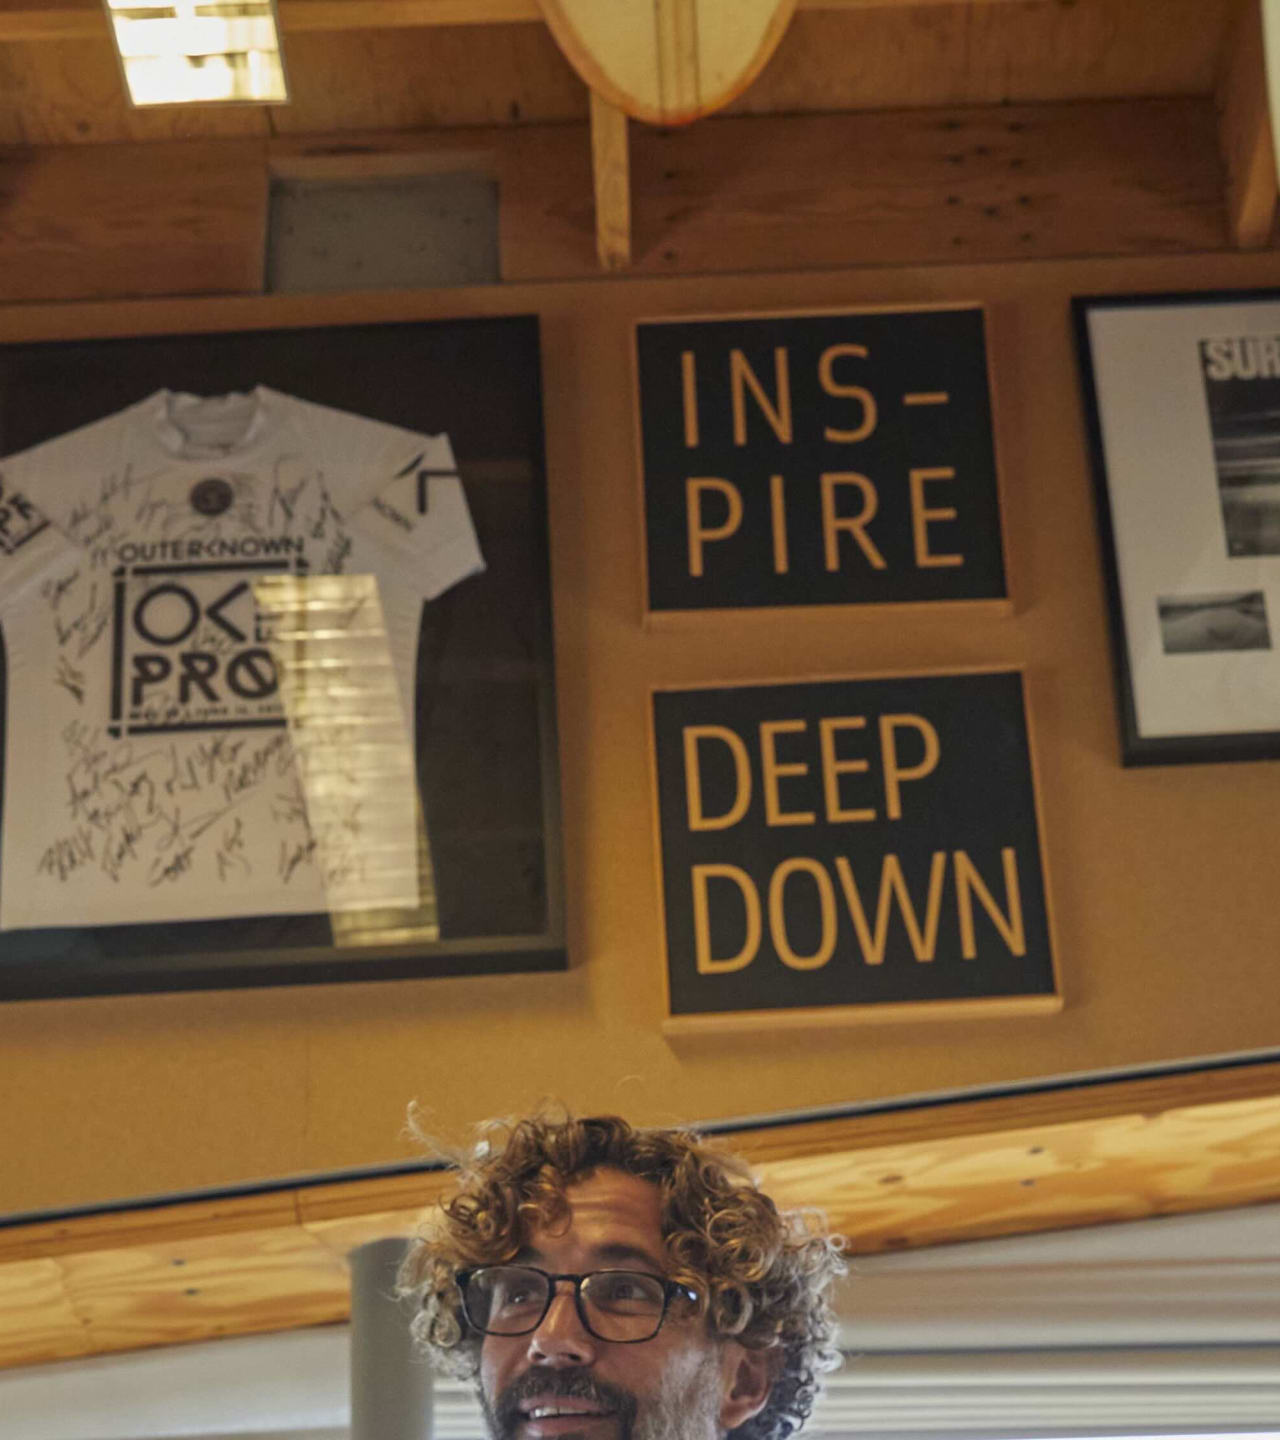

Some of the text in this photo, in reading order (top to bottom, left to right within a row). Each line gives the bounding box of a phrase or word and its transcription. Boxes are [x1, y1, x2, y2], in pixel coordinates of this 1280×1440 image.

[681, 344, 949, 448] INS-
[685, 467, 964, 577] PIRE
[131, 648, 280, 706] PRO
[683, 714, 940, 832] DEEP
[691, 847, 1027, 975] DOWN
